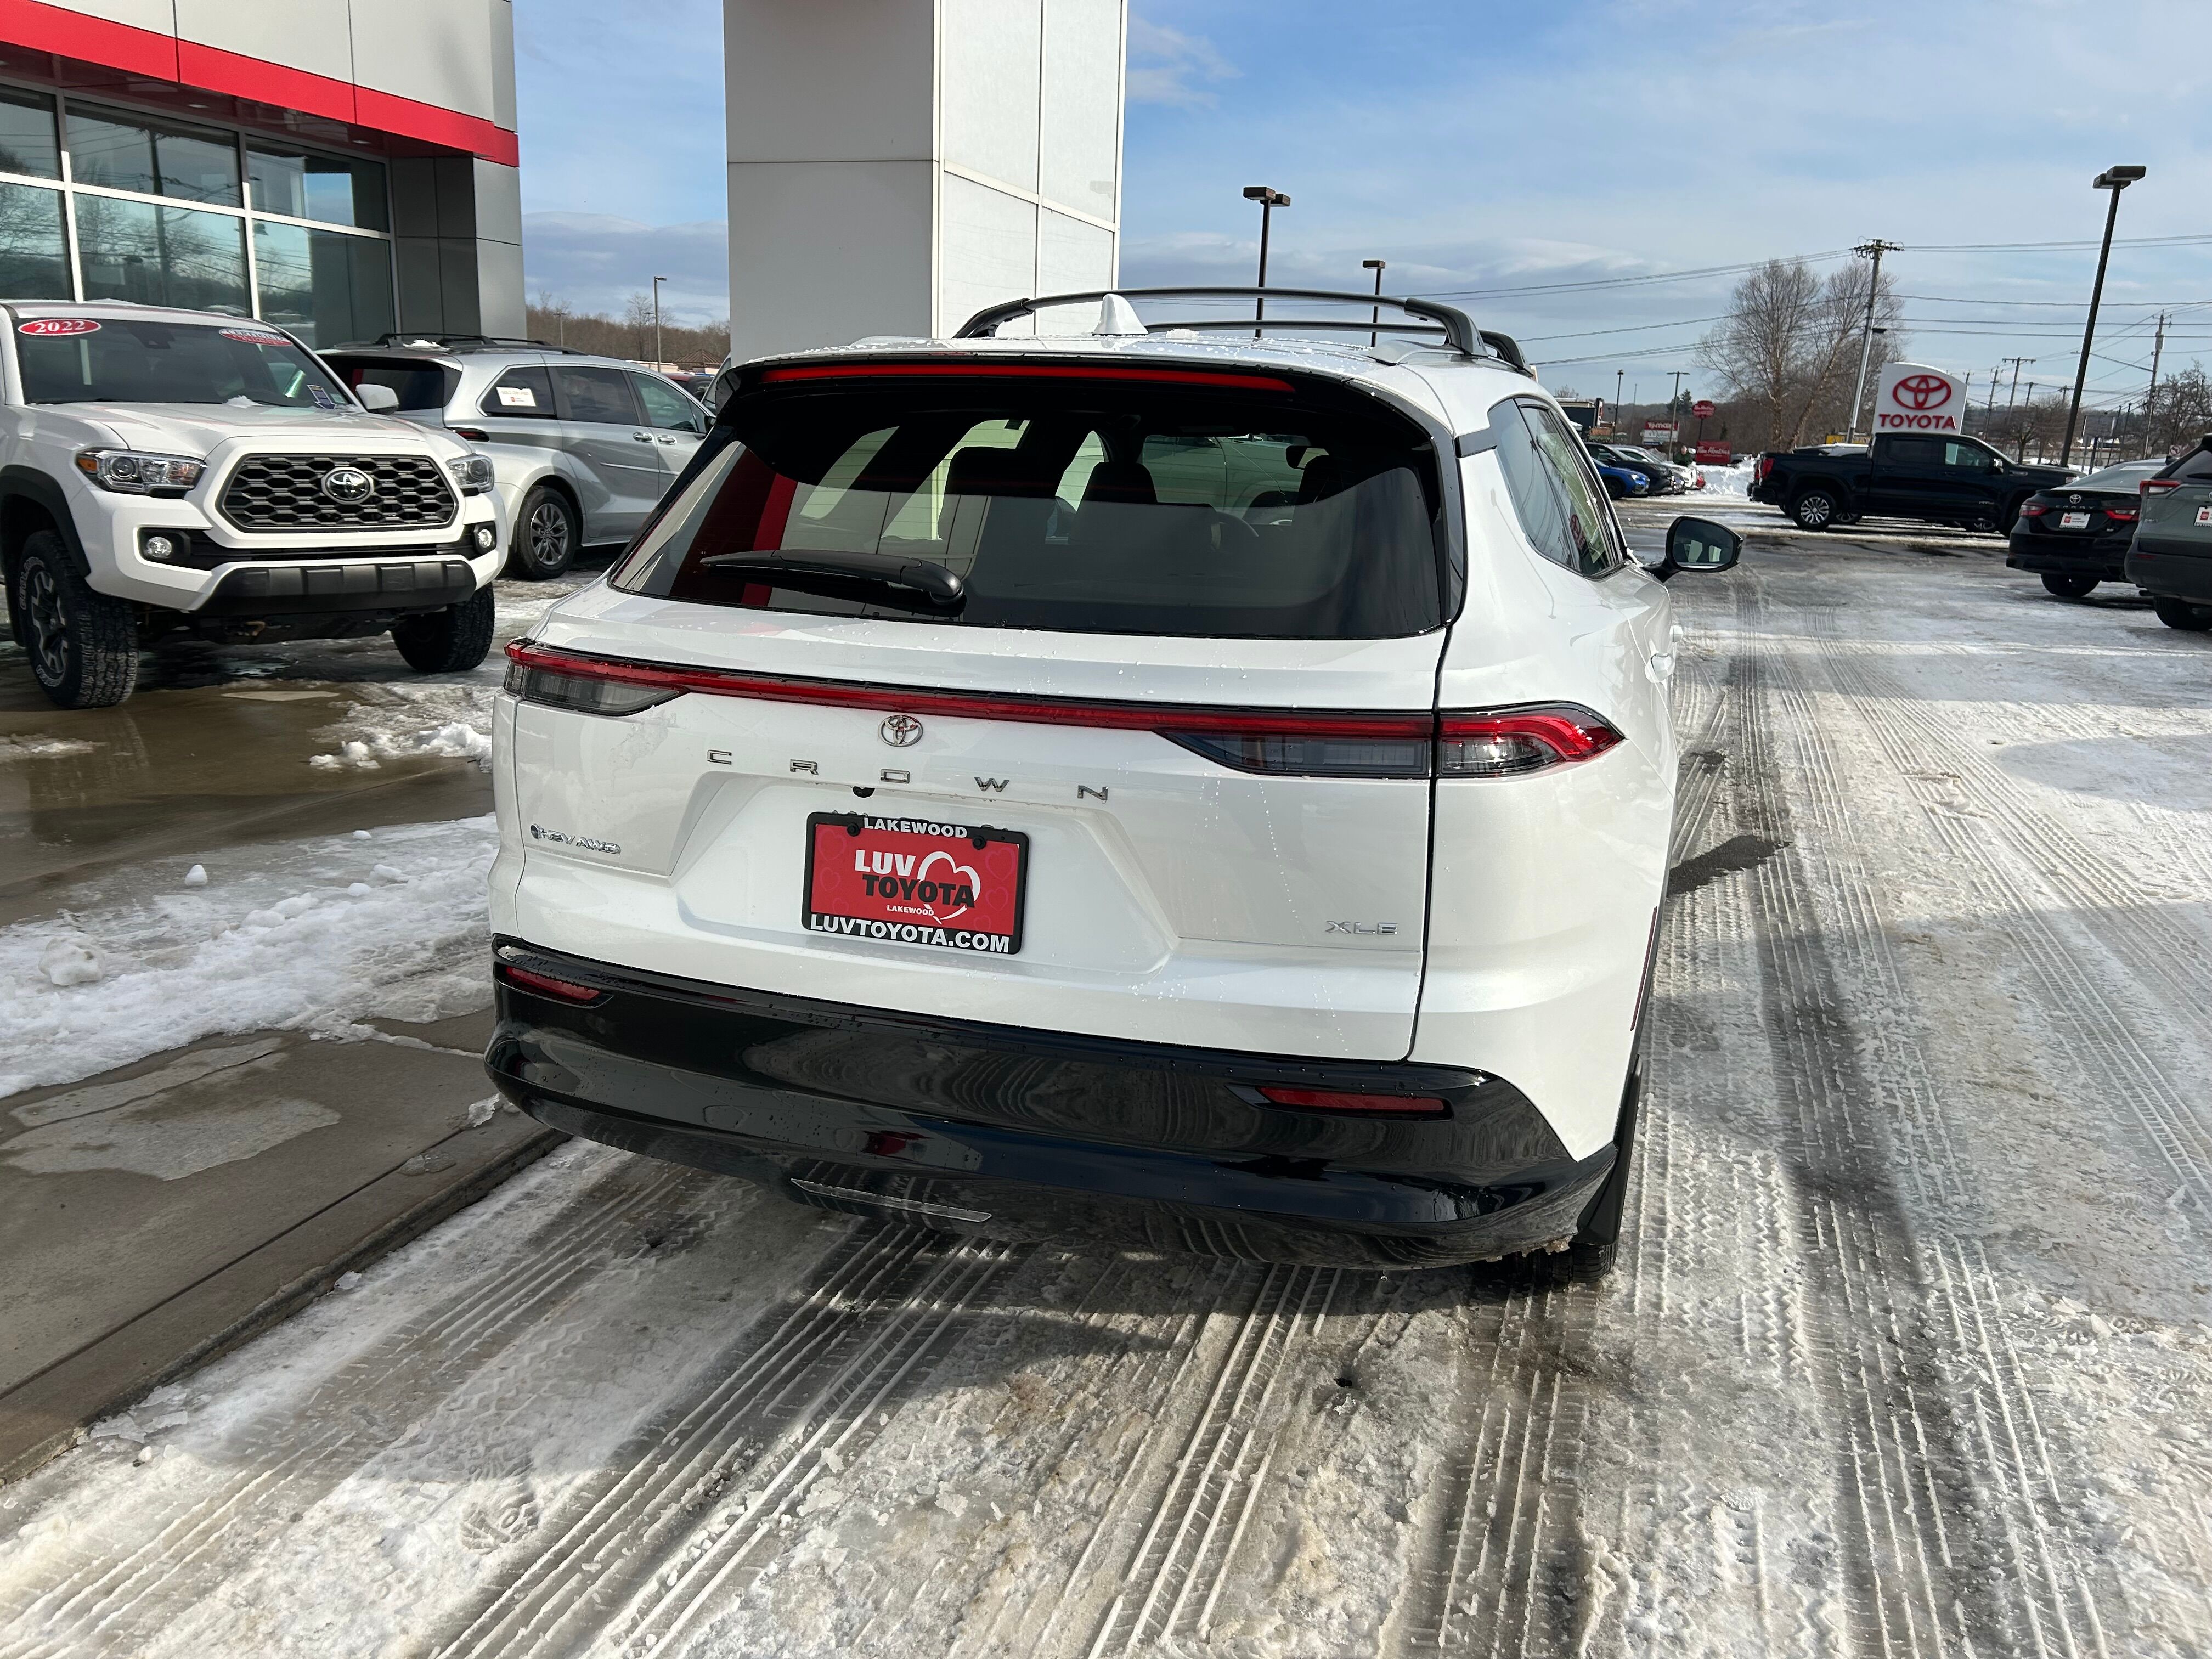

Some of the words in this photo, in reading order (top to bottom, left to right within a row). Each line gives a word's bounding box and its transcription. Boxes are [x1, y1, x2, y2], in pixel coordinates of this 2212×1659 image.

[35, 320, 86, 333] 2022
[1879, 414, 1956, 429] TOYOTA
[706, 749, 1109, 801] CROWN
[864, 817, 967, 838] LAKEWOOD
[854, 849, 916, 877] LUV
[862, 874, 975, 908] TOYOTA
[887, 904, 934, 916] LAKEWOOD
[810, 913, 1010, 953] LUVTOYOTA.COM
[1324, 920, 1398, 935] XLE
